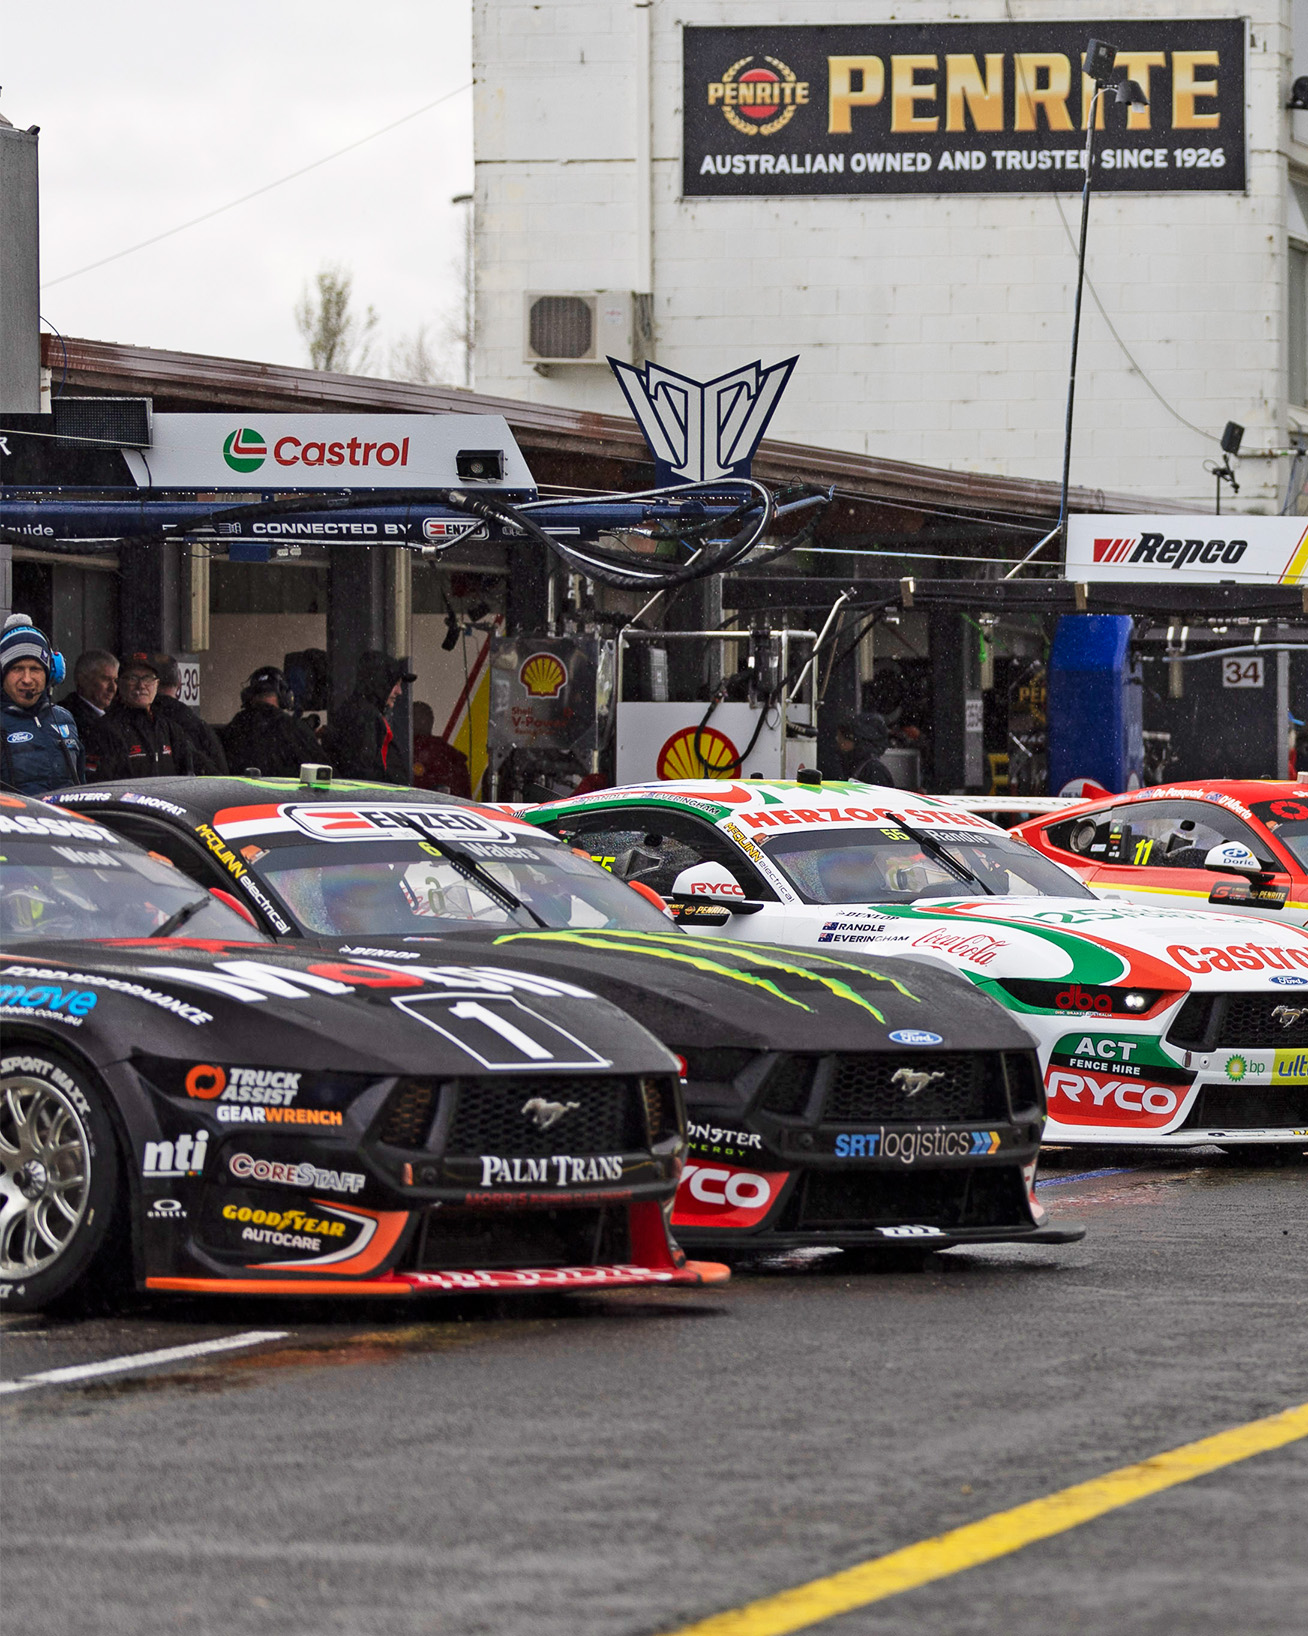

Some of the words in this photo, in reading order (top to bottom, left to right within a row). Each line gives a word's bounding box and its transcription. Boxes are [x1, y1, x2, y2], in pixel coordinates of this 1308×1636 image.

[707, 81, 809, 107] PENRITE
[827, 50, 1221, 134] PENRITE
[700, 153, 844, 176] AUSTRALIAN
[850, 152, 931, 173] OWNED
[937, 150, 984, 171] AND
[1101, 147, 1168, 170] SINCE
[1174, 147, 1226, 169] 1926
[273, 436, 410, 467] Castrol
[253, 522, 377, 535] CONNECTED
[384, 524, 412, 535] BY
[1129, 531, 1248, 569] Repco
[1225, 662, 1259, 684] 34
[59, 792, 112, 803] WATERS
[136, 795, 187, 816] MOFFAT
[585, 792, 630, 803] RANDLE
[654, 792, 721, 816] EVERINGHAM
[0, 816, 120, 844] ASSIST
[359, 811, 487, 831] ENZED
[739, 808, 902, 829] HERZOG
[904, 809, 998, 831] STEEL
[879, 828, 911, 842] 55
[924, 828, 990, 846] Randle
[418, 841, 442, 857] 6
[459, 842, 541, 860] Waters
[1133, 839, 1154, 866] 11
[1223, 858, 1255, 867] Doric
[758, 859, 796, 903] electrical
[240, 874, 290, 935] electrical
[845, 910, 901, 921] DUNLOP
[833, 934, 911, 943] EVERINGHAM
[838, 922, 886, 933] RANDLE
[352, 946, 421, 960] DUNLOP
[1273, 976, 1307, 986] Ford
[69, 973, 214, 1026] PERFORMANCE
[1055, 985, 1113, 1013] dba
[448, 1001, 554, 1060] 1
[1074, 1036, 1137, 1061] ACT
[1069, 1058, 1108, 1072] FENCE
[1112, 1063, 1141, 1076] HIRE
[1248, 1058, 1266, 1078] bp
[0, 1056, 54, 1076] SPORT
[50, 1067, 92, 1115] MAXX
[229, 1068, 302, 1090] TRUCK
[220, 1085, 298, 1106] ASSIST
[1048, 1071, 1177, 1115] RYCO
[216, 1105, 343, 1126] GEARWRENCH
[143, 1129, 210, 1172] nti
[688, 1142, 746, 1158] NERGY
[147, 1210, 187, 1218] OAKLEY
[222, 1204, 346, 1237] GOODYEAR
[242, 1227, 322, 1251] AUTOCARE
